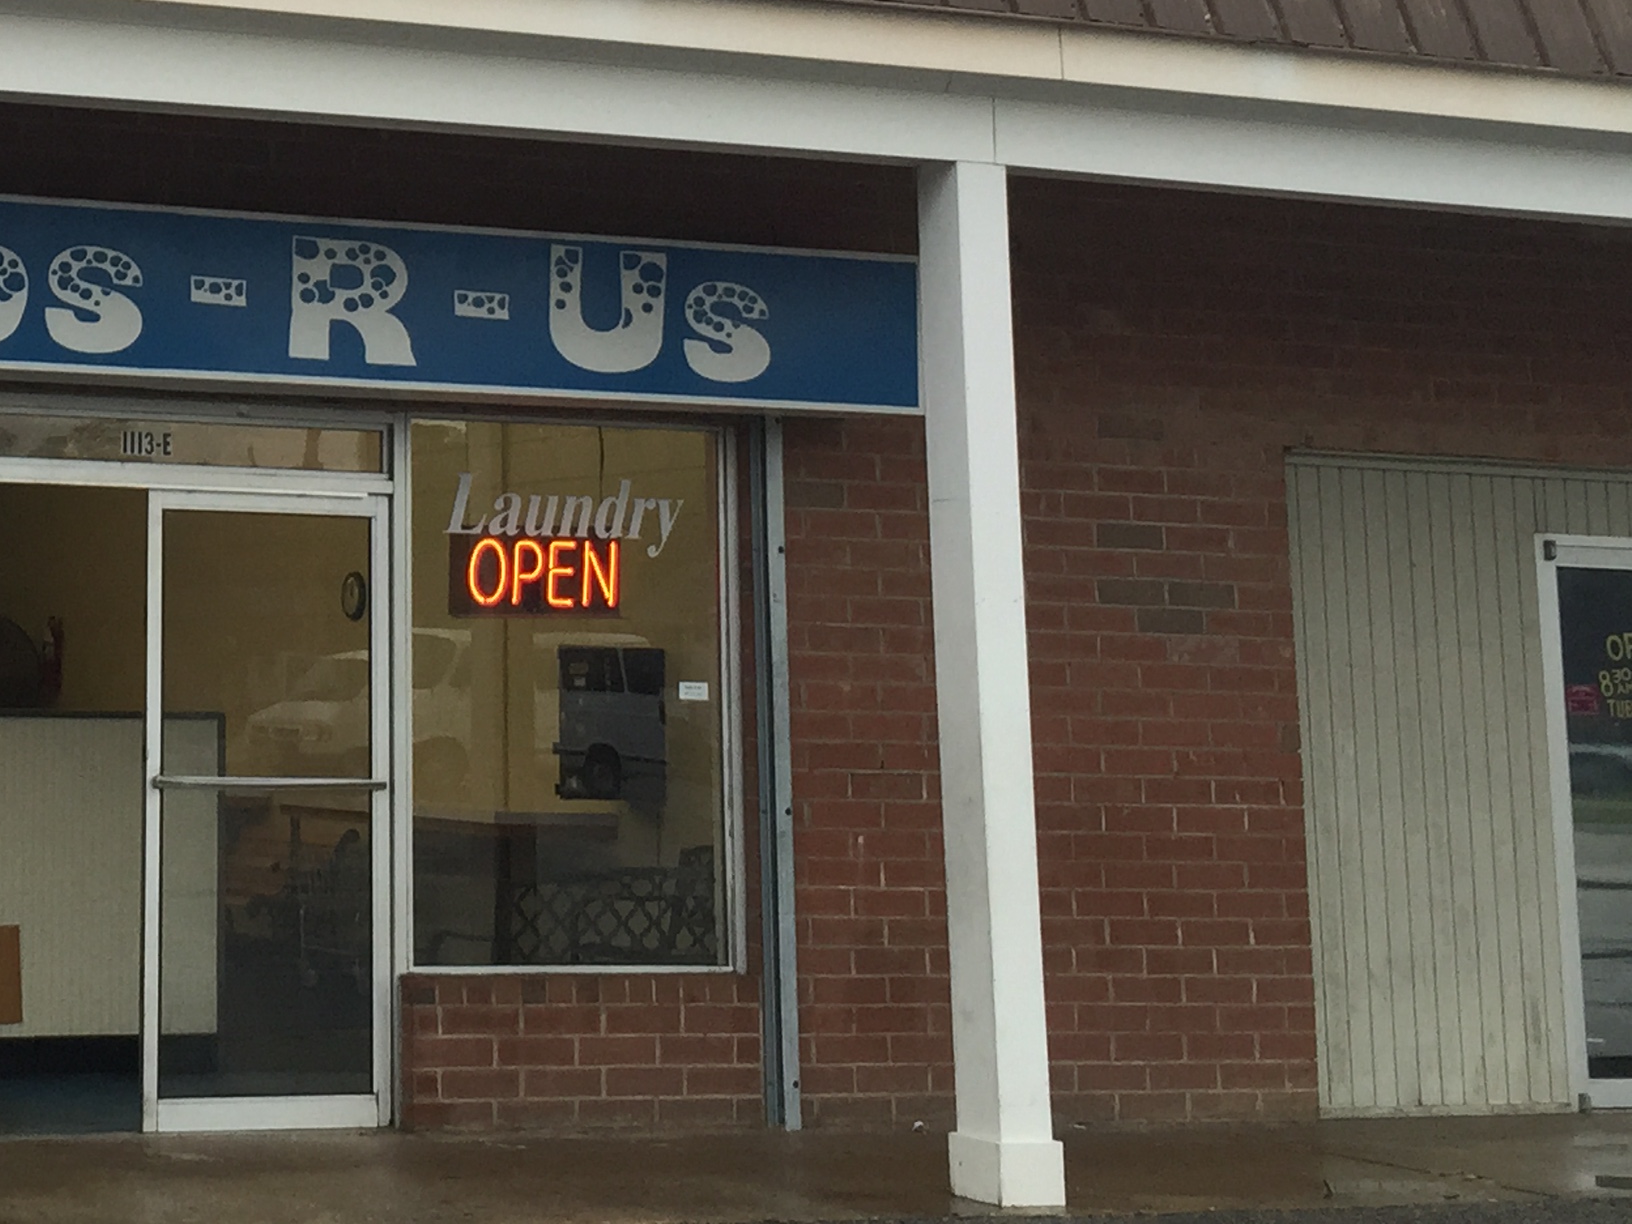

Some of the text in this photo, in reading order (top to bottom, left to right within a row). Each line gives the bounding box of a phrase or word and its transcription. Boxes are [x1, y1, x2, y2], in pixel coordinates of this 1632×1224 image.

[122, 430, 172, 456] 1113-E
[443, 472, 684, 559] Laundry
[467, 537, 620, 608] OPEN
